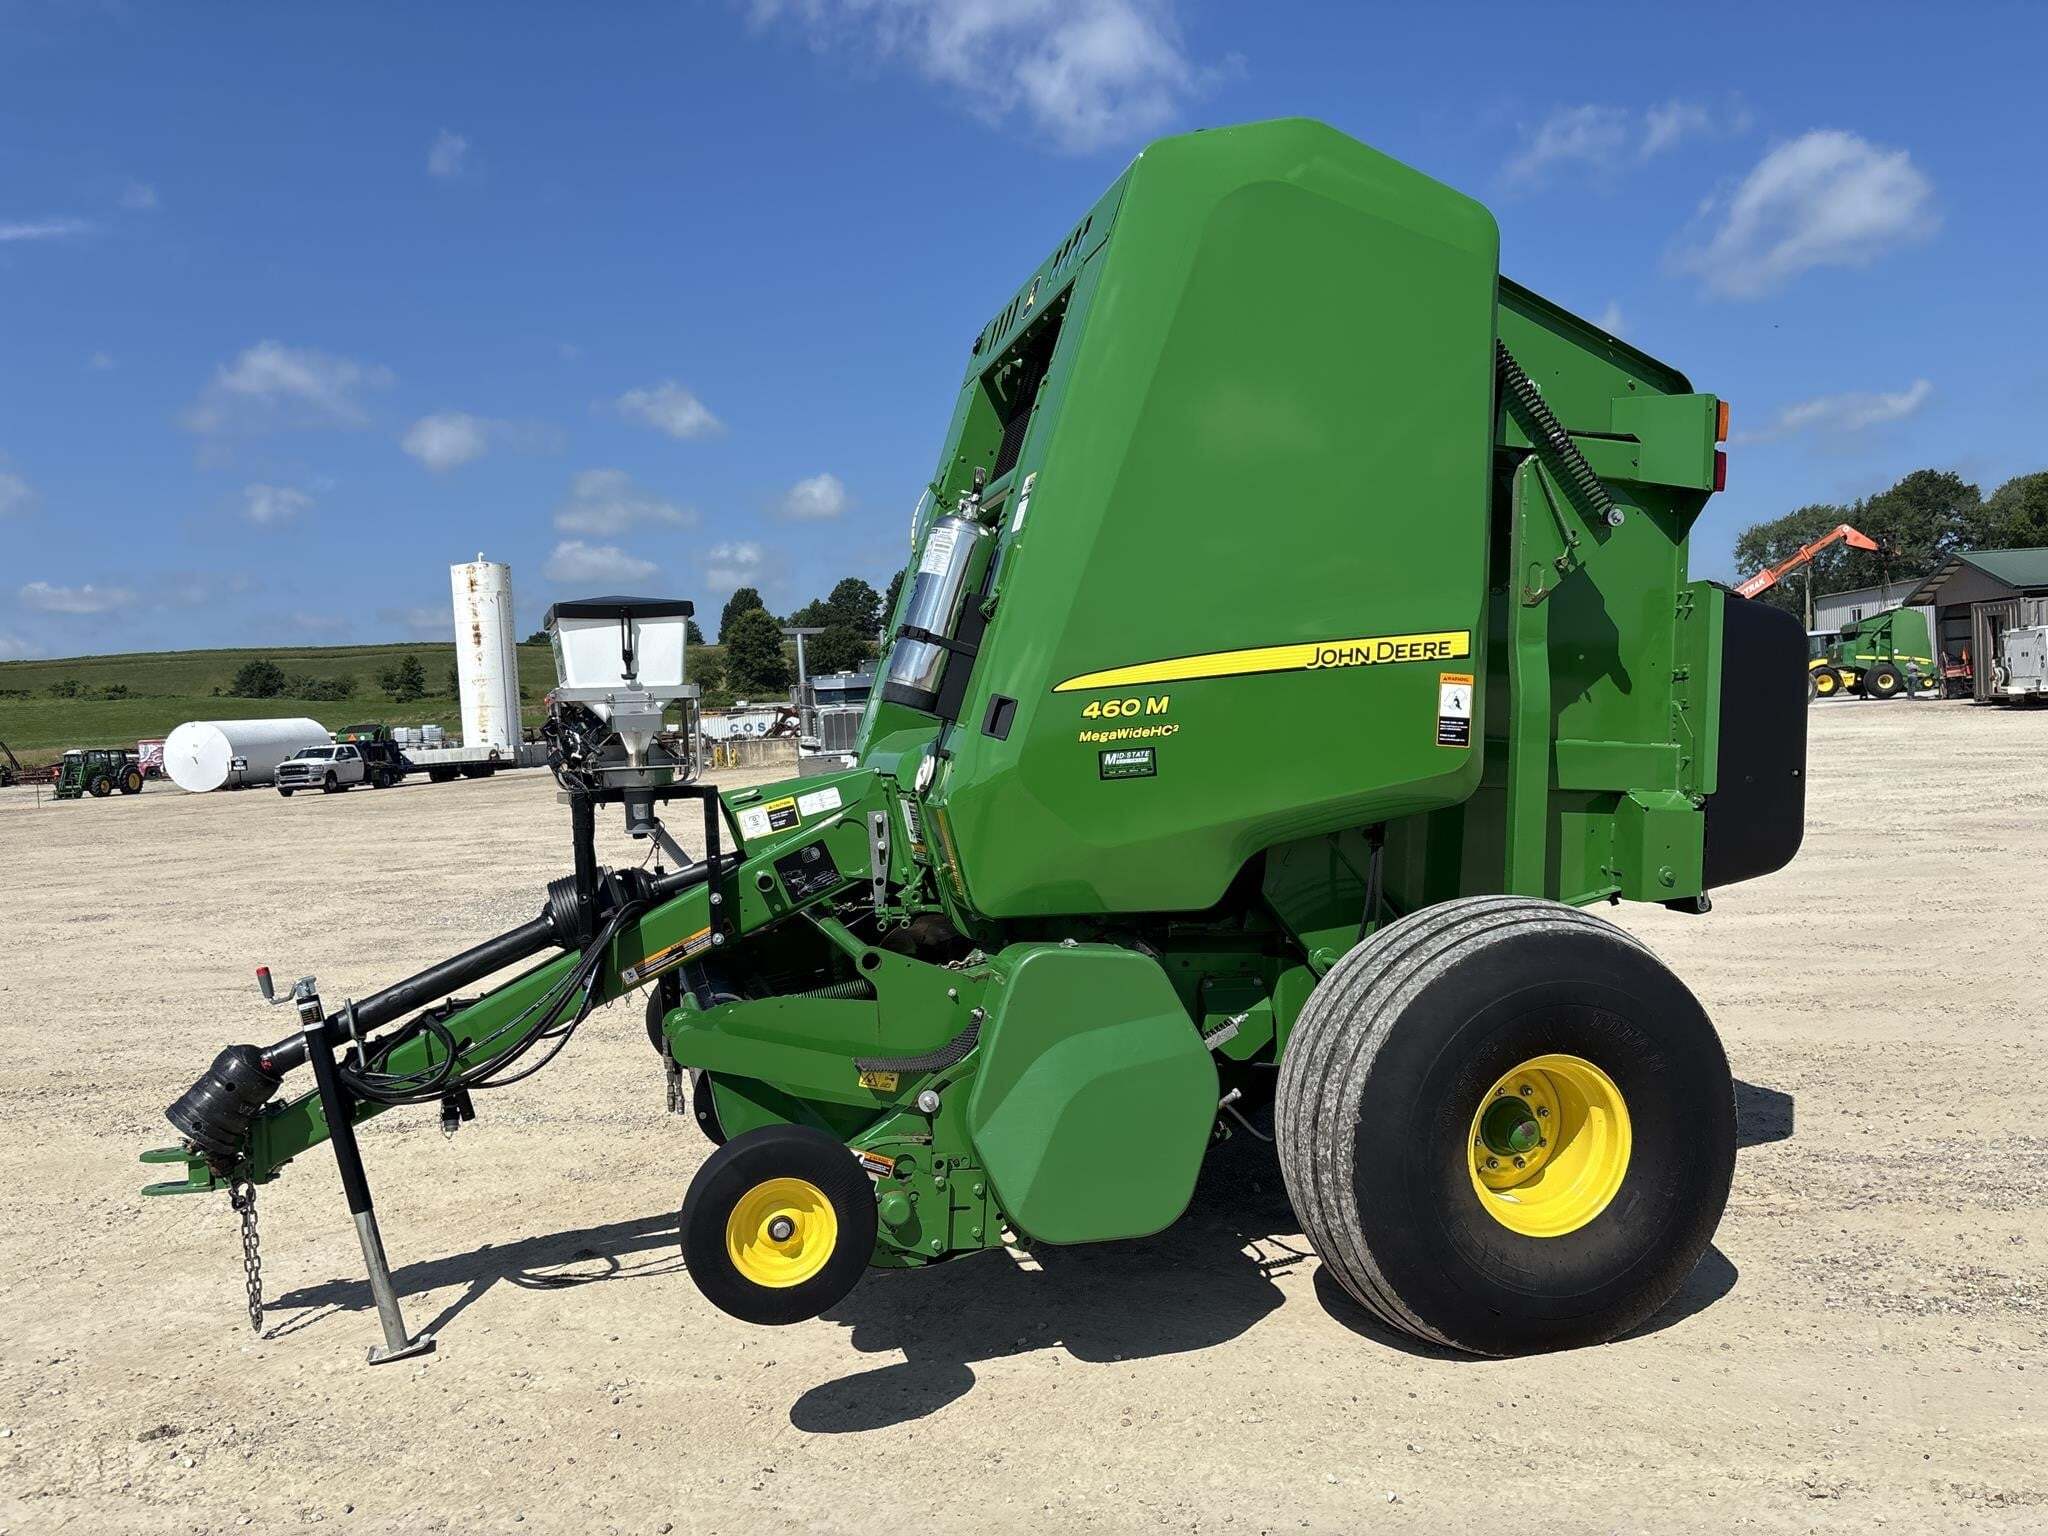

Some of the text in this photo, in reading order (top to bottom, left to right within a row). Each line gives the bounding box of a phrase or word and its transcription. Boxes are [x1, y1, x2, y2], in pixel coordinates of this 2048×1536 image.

[1742, 577, 1766, 594] TRAK
[1307, 641, 1452, 667] JOHN DEERE
[1082, 695, 1170, 719] 460 M
